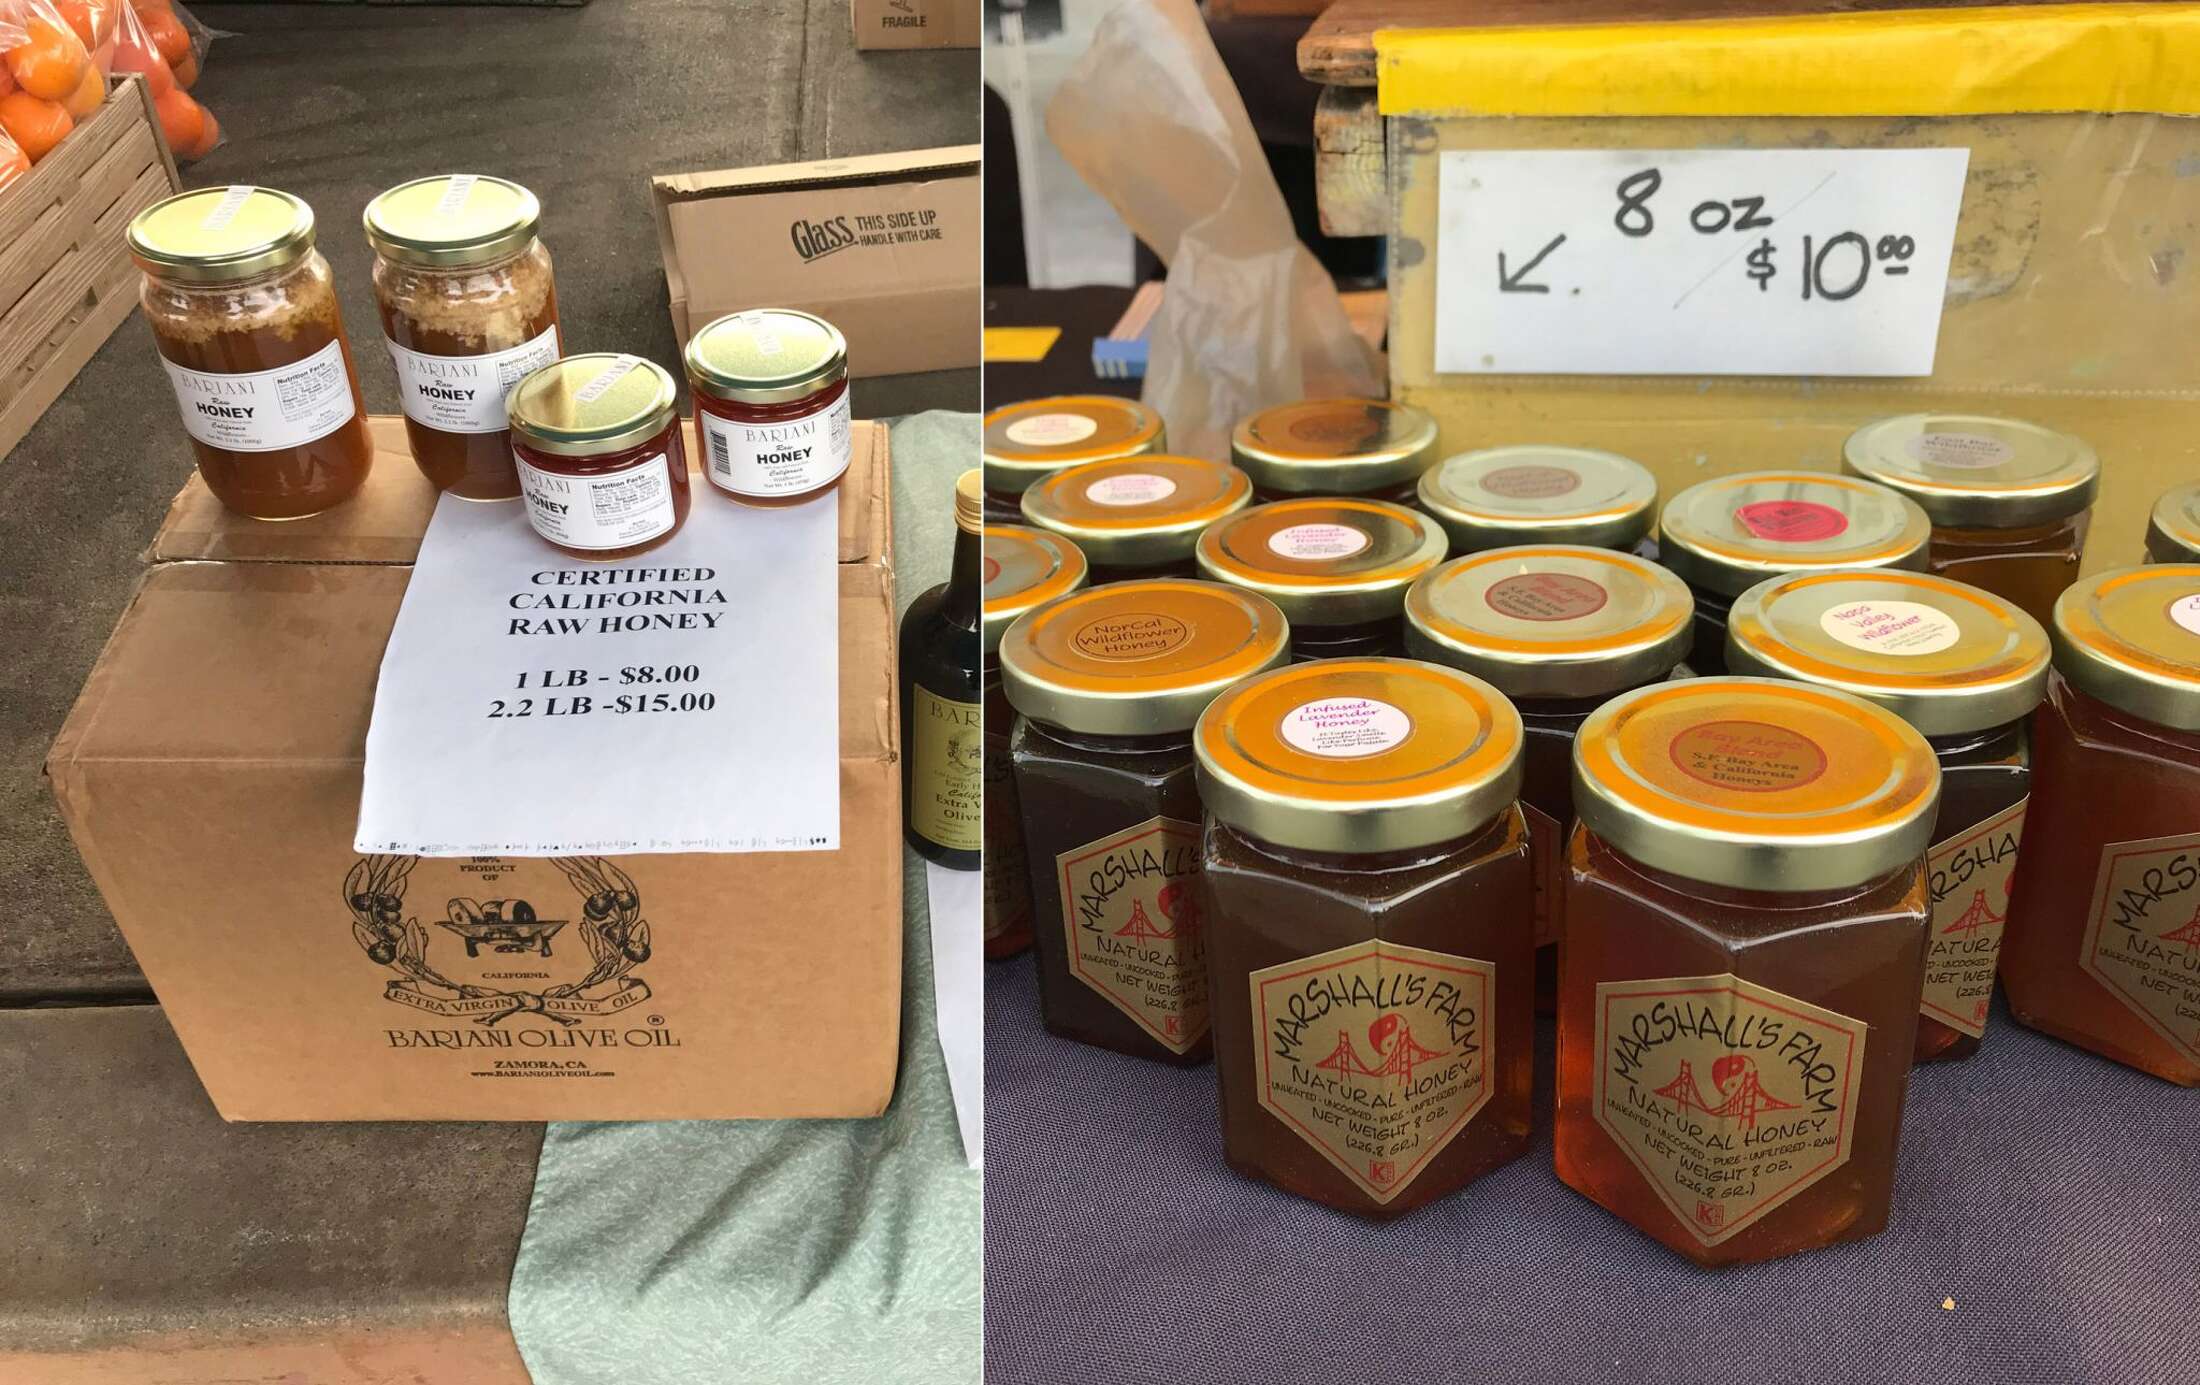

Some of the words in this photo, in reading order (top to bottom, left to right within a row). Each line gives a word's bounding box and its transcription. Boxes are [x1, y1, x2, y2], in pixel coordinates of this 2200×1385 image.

[883, 16, 926, 28] FRAGILE
[1615, 168, 1661, 236] 8
[1690, 197, 1773, 234] oz
[855, 215, 884, 230] THIS
[888, 212, 915, 228] SIDE
[919, 210, 936, 225] UP
[791, 216, 855, 259] Glass
[860, 233, 893, 247] HANDLE
[896, 231, 918, 244] WITH
[920, 228, 942, 242] CARE
[277, 372, 308, 384] Nutrition
[310, 362, 325, 373] Facts
[408, 357, 478, 377] BARIANI
[182, 375, 255, 395] BARIANI
[419, 385, 475, 400] HONEY
[197, 402, 254, 418] HONEY
[746, 421, 816, 442] BARIANI
[756, 447, 812, 464] HONEY
[592, 481, 624, 490] Nutrition
[626, 475, 644, 484] Facts
[526, 491, 569, 515] HONEY
[531, 568, 715, 586] CERTIFIED
[509, 589, 728, 610] CALIFORNIA
[508, 618, 590, 635] RAW
[598, 612, 725, 634] HONEY
[1095, 619, 1161, 634] NorCal
[1080, 627, 1181, 646] Wildflower
[1105, 640, 1167, 653] Honey
[516, 672, 529, 689] 1
[542, 669, 588, 688] LB
[620, 664, 699, 685] $8.00
[488, 699, 533, 718] 2.2
[545, 696, 592, 715] LB
[1299, 710, 1380, 721] Lavender
[1304, 701, 1371, 713] Infused
[1315, 719, 1370, 728] Honey
[1692, 752, 1720, 762] S.F.
[1727, 756, 1757, 766] Bay
[1761, 761, 1799, 770] Area
[1693, 761, 1706, 769] &
[1713, 764, 1795, 779] California
[1712, 773, 1772, 786] Honeys
[937, 792, 967, 808] Extra
[1931, 833, 2018, 902] RSHA
[2112, 855, 2200, 932] MARS
[1097, 935, 1185, 968] NATURAL
[1928, 937, 2000, 955] ATURA
[2127, 935, 2200, 972] NATU
[1116, 972, 1143, 989] NET
[1927, 972, 1959, 984] NET
[2141, 975, 2178, 995] NET
[2184, 989, 2200, 1004] W
[393, 990, 446, 1012] EXTRA
[451, 999, 514, 1013] VIRGIN
[547, 1000, 599, 1013] OLIVE
[612, 992, 638, 1009] OIL
[1274, 973, 1427, 1062] MARSHALL'S
[1425, 980, 1480, 1057] FARM
[384, 1030, 512, 1049] BARIANI
[518, 1029, 618, 1048] OLIVE
[624, 1029, 681, 1047] OIL
[566, 1061, 587, 1069] CA
[1614, 1002, 1783, 1084] MARSHALL'S
[1778, 1031, 1838, 1114] FARM
[1291, 1064, 1397, 1110] NATURAL
[1404, 1058, 1473, 1102] HONEY
[1272, 1082, 1317, 1102] UNHEATED
[1324, 1099, 1372, 1122] UNCOOKED
[1379, 1111, 1404, 1124] PURE
[1411, 1085, 1458, 1114] UNFILTERED
[1463, 1072, 1482, 1091] RAW
[1312, 1106, 1345, 1127] NET
[1349, 1120, 1409, 1141] WEIGHT
[1414, 1116, 1422, 1129] 8
[1629, 1086, 1735, 1151] NATURAL
[1744, 1117, 1828, 1147] HONEY
[1607, 1098, 1651, 1129] UNHEATED
[1657, 1126, 1705, 1161] UNCOOKED
[1713, 1155, 1742, 1167] PURE
[1749, 1141, 1805, 1161] UNFILTERED
[1814, 1135, 1838, 1148] RAW
[1644, 1133, 1675, 1161] NET
[1680, 1156, 1747, 1183] WEIGHT
[1752, 1165, 1760, 1178] 8
